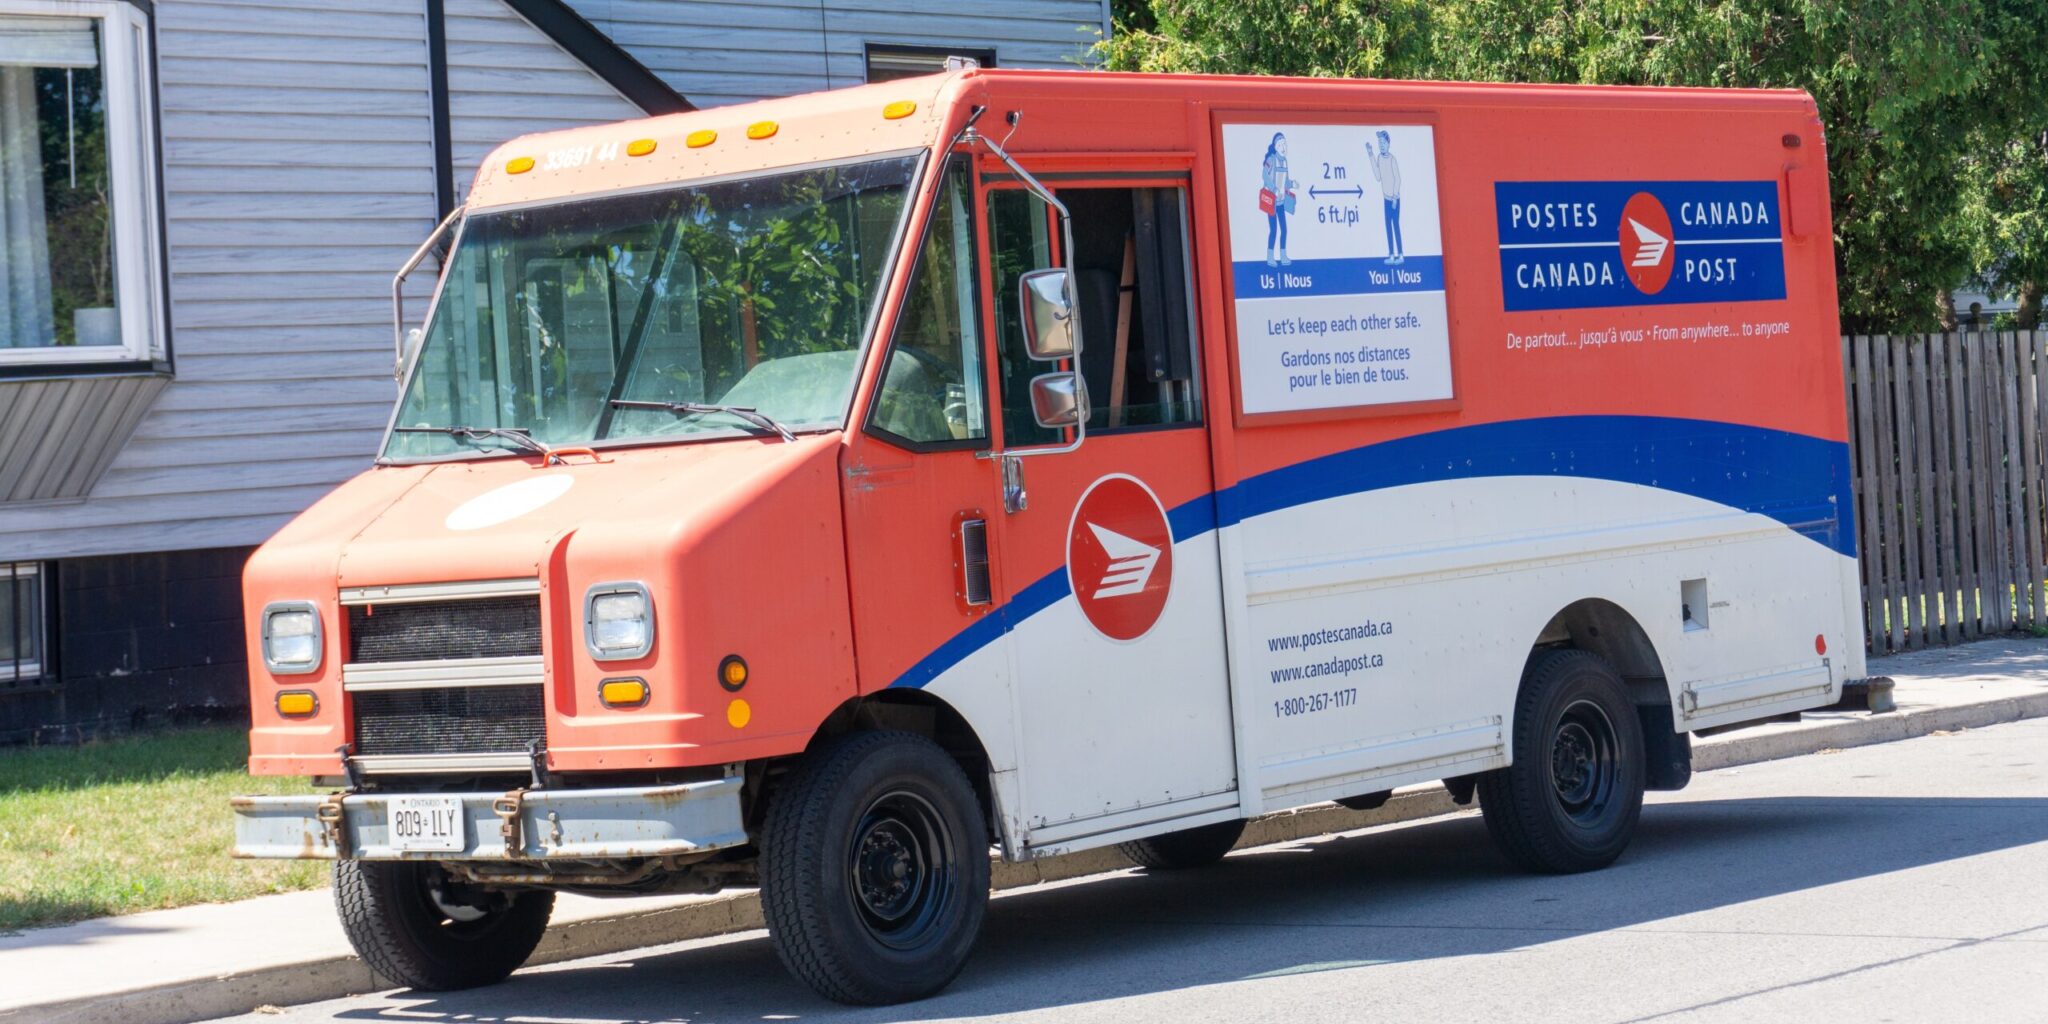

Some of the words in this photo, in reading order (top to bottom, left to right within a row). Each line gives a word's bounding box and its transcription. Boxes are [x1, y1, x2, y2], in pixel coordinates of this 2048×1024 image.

[597, 142, 618, 161] 44
[1323, 163, 1330, 179] 2
[1334, 166, 1346, 179] m
[1318, 206, 1326, 223] 6
[1328, 205, 1359, 227] ft./pi
[1511, 202, 1597, 228] POSTES
[1681, 201, 1769, 225] CANADA
[1260, 274, 1275, 289] Us
[1284, 273, 1312, 288] Nous
[1369, 270, 1388, 285] You
[1397, 269, 1421, 284] Vous
[1516, 261, 1614, 289] CANADA
[1686, 258, 1737, 282] POST
[1268, 318, 1295, 336] Let's
[1299, 317, 1327, 336] keep
[1331, 315, 1357, 332] each
[1361, 314, 1391, 330] other
[1394, 312, 1421, 329] safe.
[1507, 333, 1522, 349] De
[1525, 331, 1576, 352] partout...
[1579, 330, 1617, 352] jusqu'à
[1620, 329, 1643, 342] vous
[1653, 325, 1678, 340] From
[1681, 322, 1739, 344] anywhere...
[1742, 322, 1752, 337] to
[1755, 321, 1790, 340] anyone
[1281, 350, 1331, 367] Gardons
[1335, 351, 1355, 365] nos
[1358, 346, 1410, 364] distances
[1289, 372, 1317, 391] pour
[1321, 370, 1331, 386] le
[1335, 368, 1360, 385] bien
[1364, 367, 1377, 383] de
[1381, 367, 1408, 382] tous.
[1268, 620, 1392, 652] www.postescanada.ca
[1271, 653, 1383, 684] www.canadapost.ca
[1275, 688, 1357, 718] 1-800-267-1177
